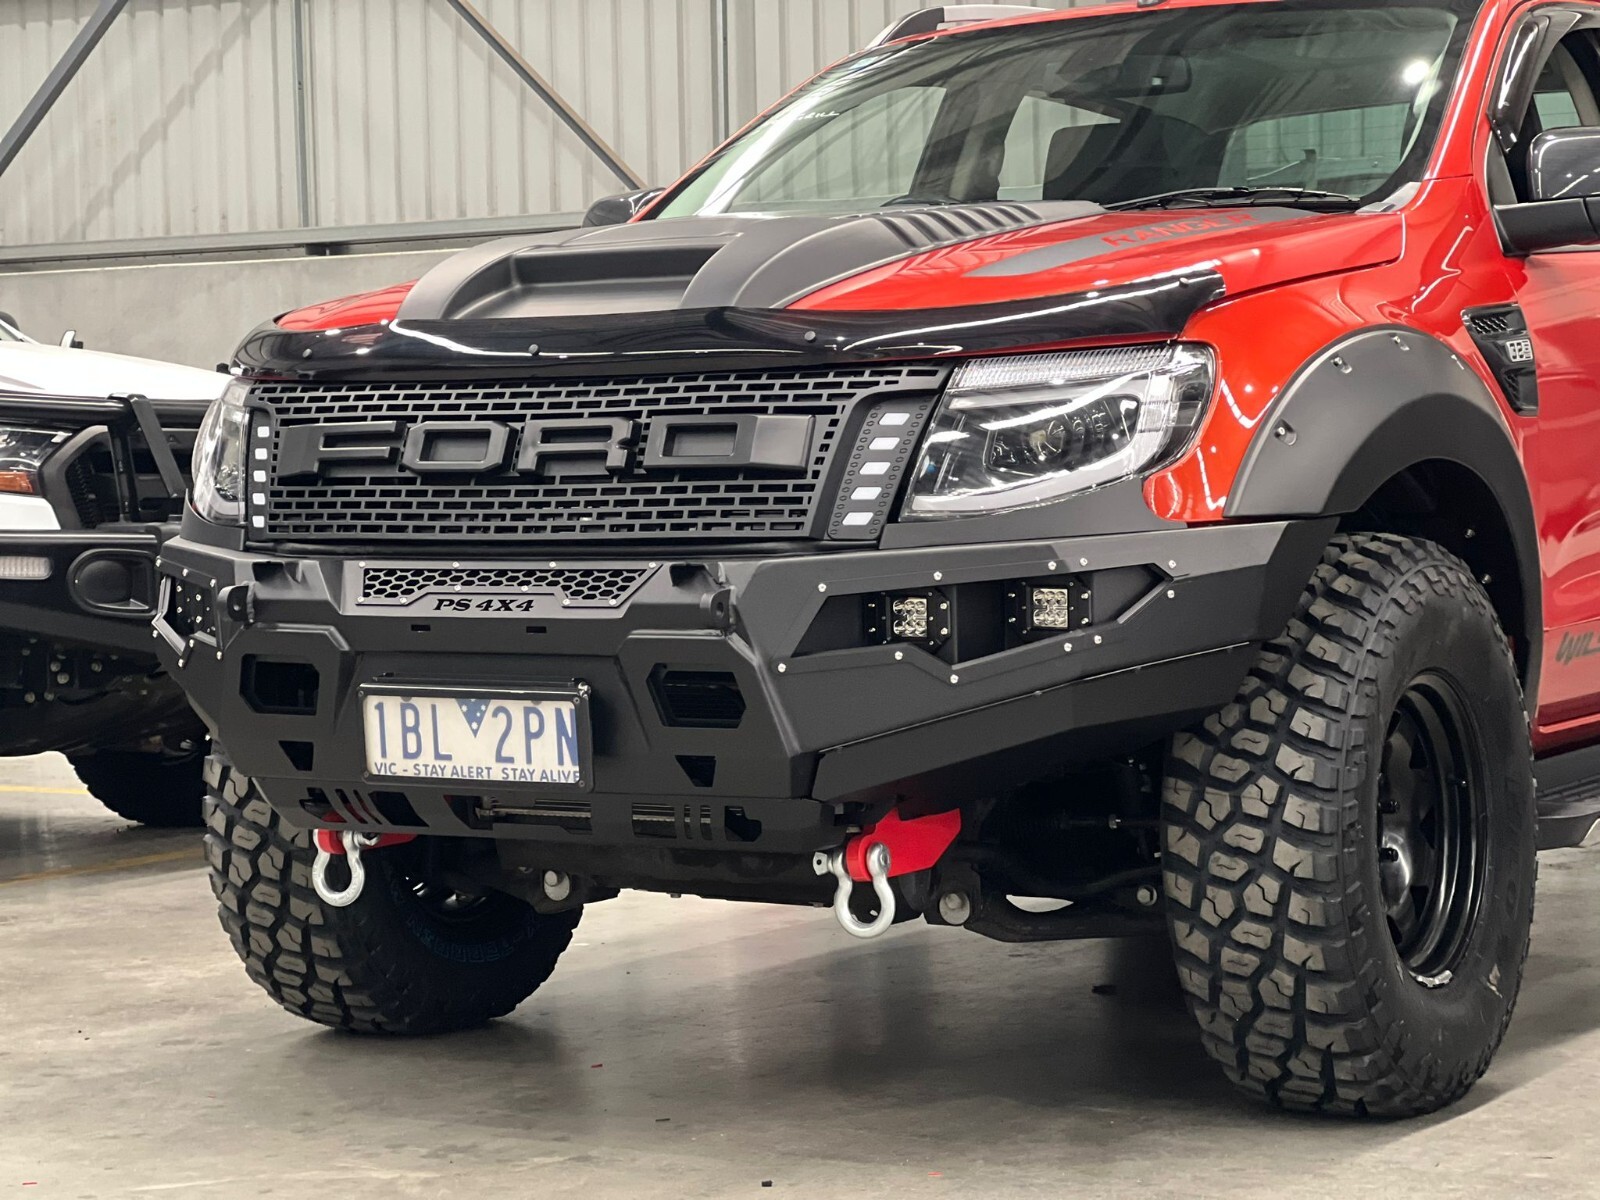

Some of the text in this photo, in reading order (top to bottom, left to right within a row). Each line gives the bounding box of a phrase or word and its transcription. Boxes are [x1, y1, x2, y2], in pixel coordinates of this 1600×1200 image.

[1101, 213, 1258, 248] RANGER
[276, 413, 816, 478] FORD
[374, 701, 579, 767] 1BL 2PN
[374, 762, 397, 775] VIC
[413, 763, 447, 778] STAY
[450, 765, 493, 780] ALERT
[501, 767, 536, 782] STAY
